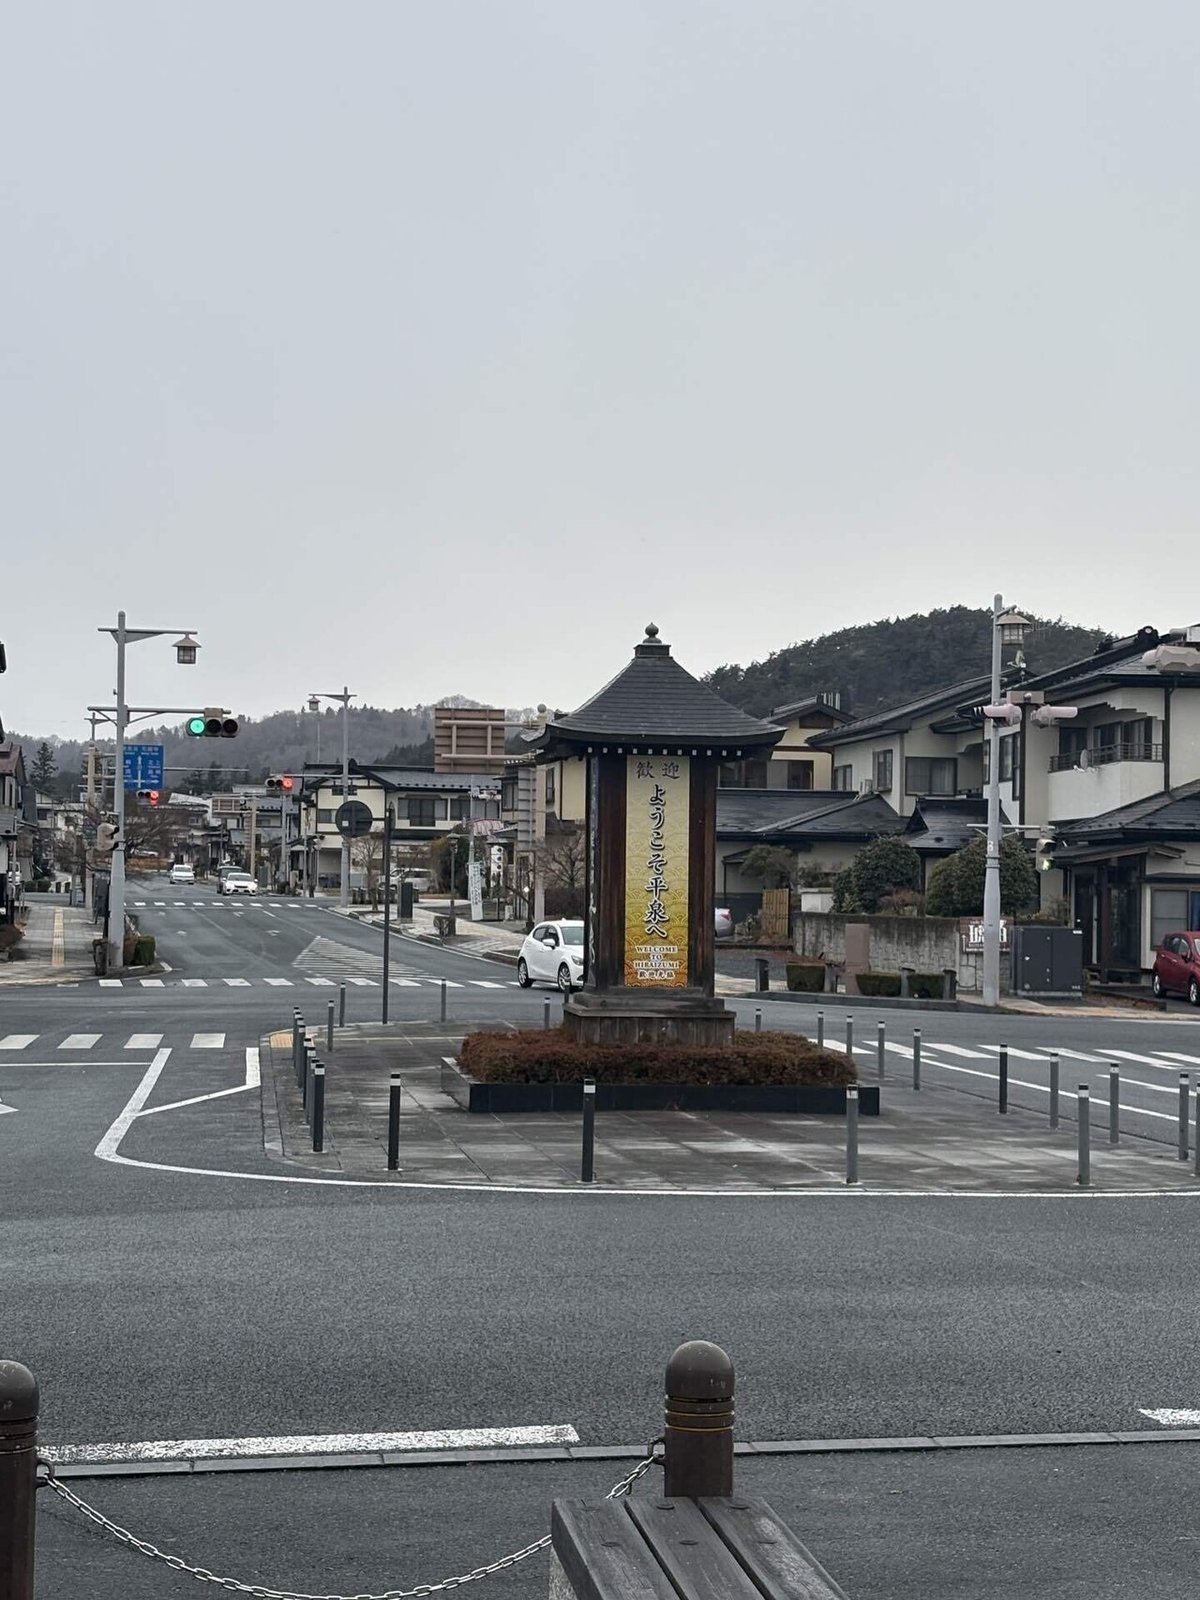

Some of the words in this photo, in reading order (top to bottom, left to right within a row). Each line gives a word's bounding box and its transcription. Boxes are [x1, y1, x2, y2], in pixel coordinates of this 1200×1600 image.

[636, 760, 681, 780] 歓迎
[645, 783, 669, 938] ようこそ平泉へ
[634, 961, 680, 969] HIRAIZUMI
